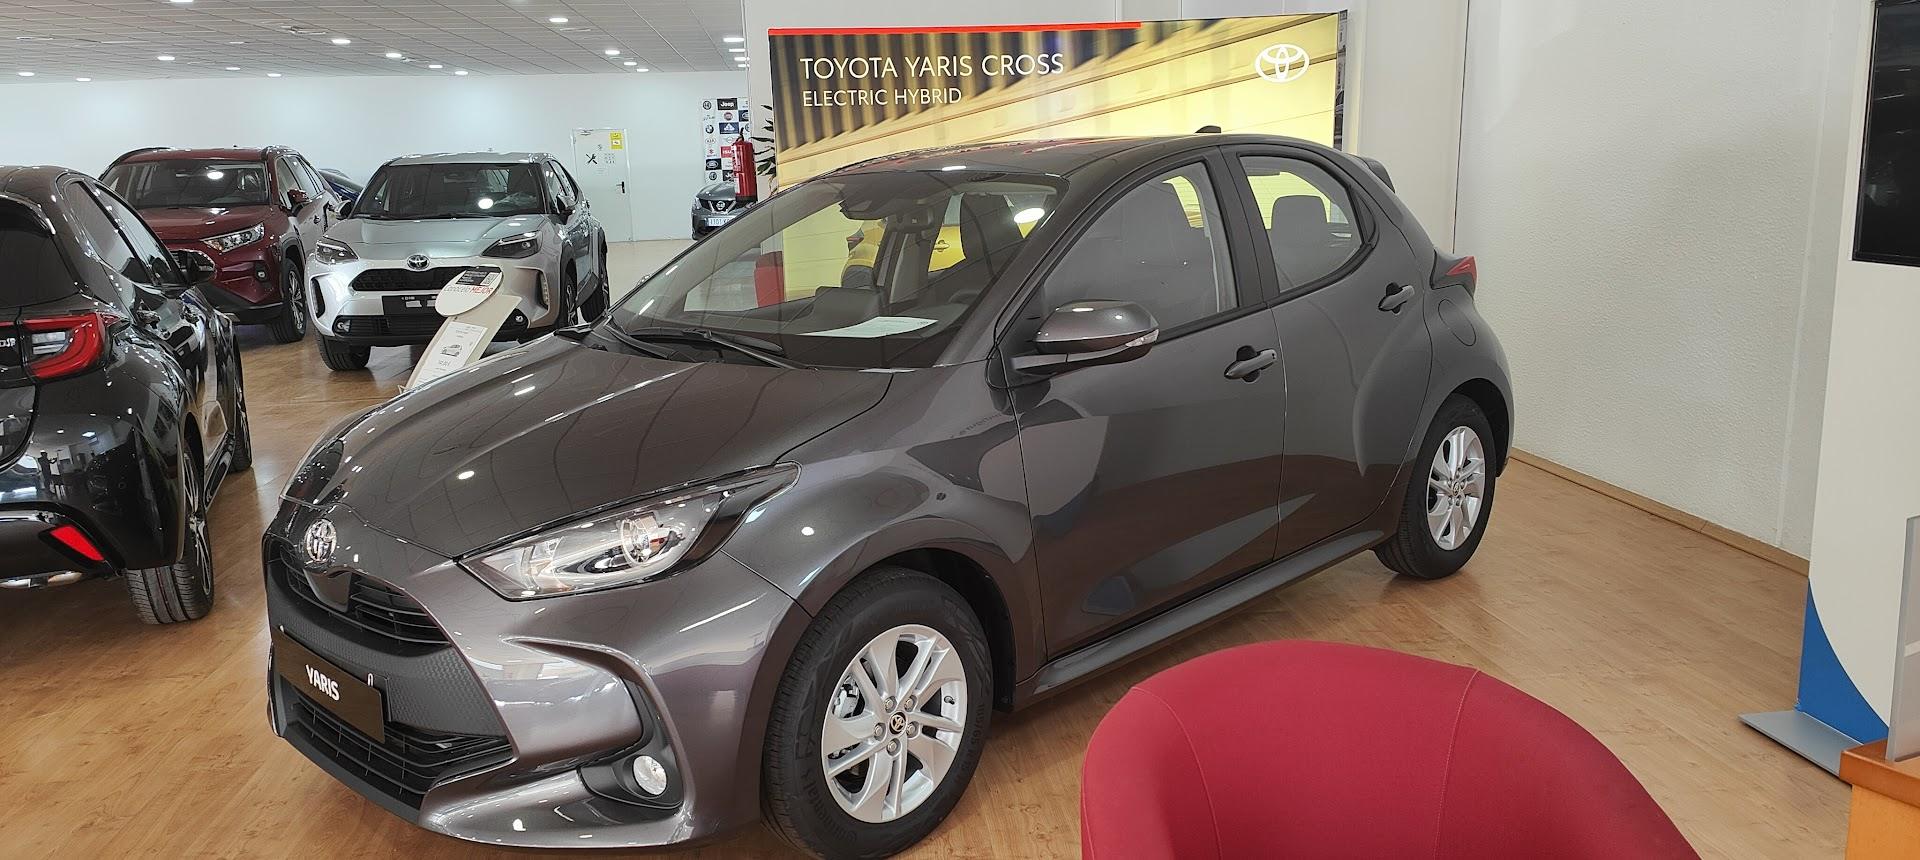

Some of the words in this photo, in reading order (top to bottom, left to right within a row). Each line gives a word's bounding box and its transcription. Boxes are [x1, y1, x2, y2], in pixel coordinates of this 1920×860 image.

[800, 57, 898, 79] TOYOTA
[905, 55, 972, 78] YARIS
[981, 53, 1064, 76] CROSS
[803, 89, 888, 107] ELECTRIC
[894, 88, 962, 104] HYBRID
[305, 664, 340, 701] YARIS
